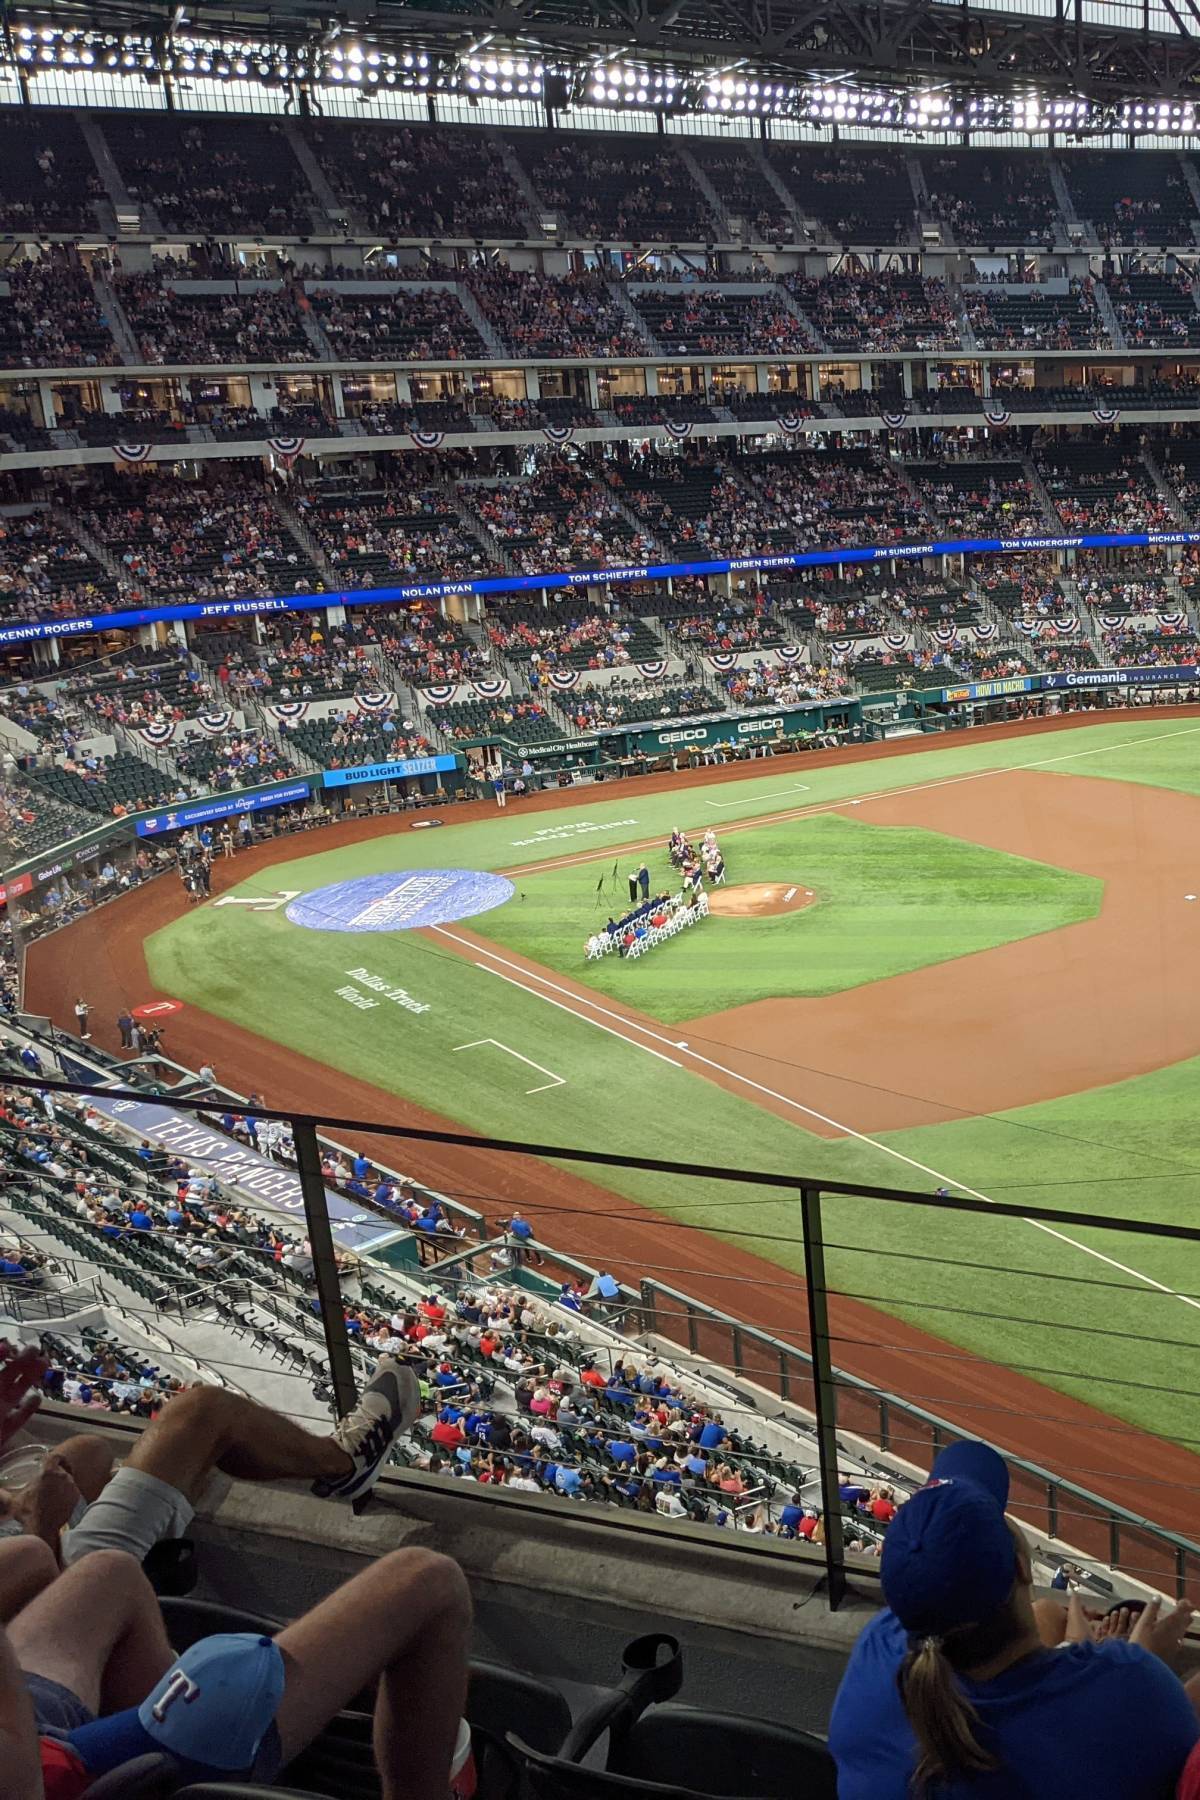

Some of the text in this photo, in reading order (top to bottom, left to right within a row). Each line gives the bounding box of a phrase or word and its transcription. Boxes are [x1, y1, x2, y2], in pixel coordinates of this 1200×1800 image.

[1021, 538, 1084, 548] VANDERGRIFF
[1148, 534, 1187, 543] MICHAEL
[873, 546, 934, 558] JIM SUNDBERG
[730, 557, 796, 569] RUBEN SIERRA
[568, 570, 648, 583] TOM SCHIEFFER
[402, 584, 472, 598] NOLAN RYAN
[200, 600, 289, 615] JEFF RUSSELL
[0, 620, 93, 640] KENNY ROGERS
[1066, 671, 1180, 684] Germania INSURANCE
[975, 684, 992, 696] HOW
[993, 683, 1002, 694] TO
[738, 718, 784, 733] GEICO
[658, 728, 707, 744] GEICO
[528, 740, 598, 755] Medical City Healthcare
[345, 758, 438, 781] BUD LIGHT SELTZER
[512, 818, 640, 846] Dallas Truck
[534, 822, 593, 836] World
[38, 870, 53, 880] Globe
[52, 864, 62, 874] Life
[334, 985, 380, 1010] World
[345, 967, 431, 1014] Dallas Truck
[143, 1000, 177, 1014] T
[146, 1116, 304, 1210] TEXAS RANGERS
[152, 1668, 200, 1723] T
